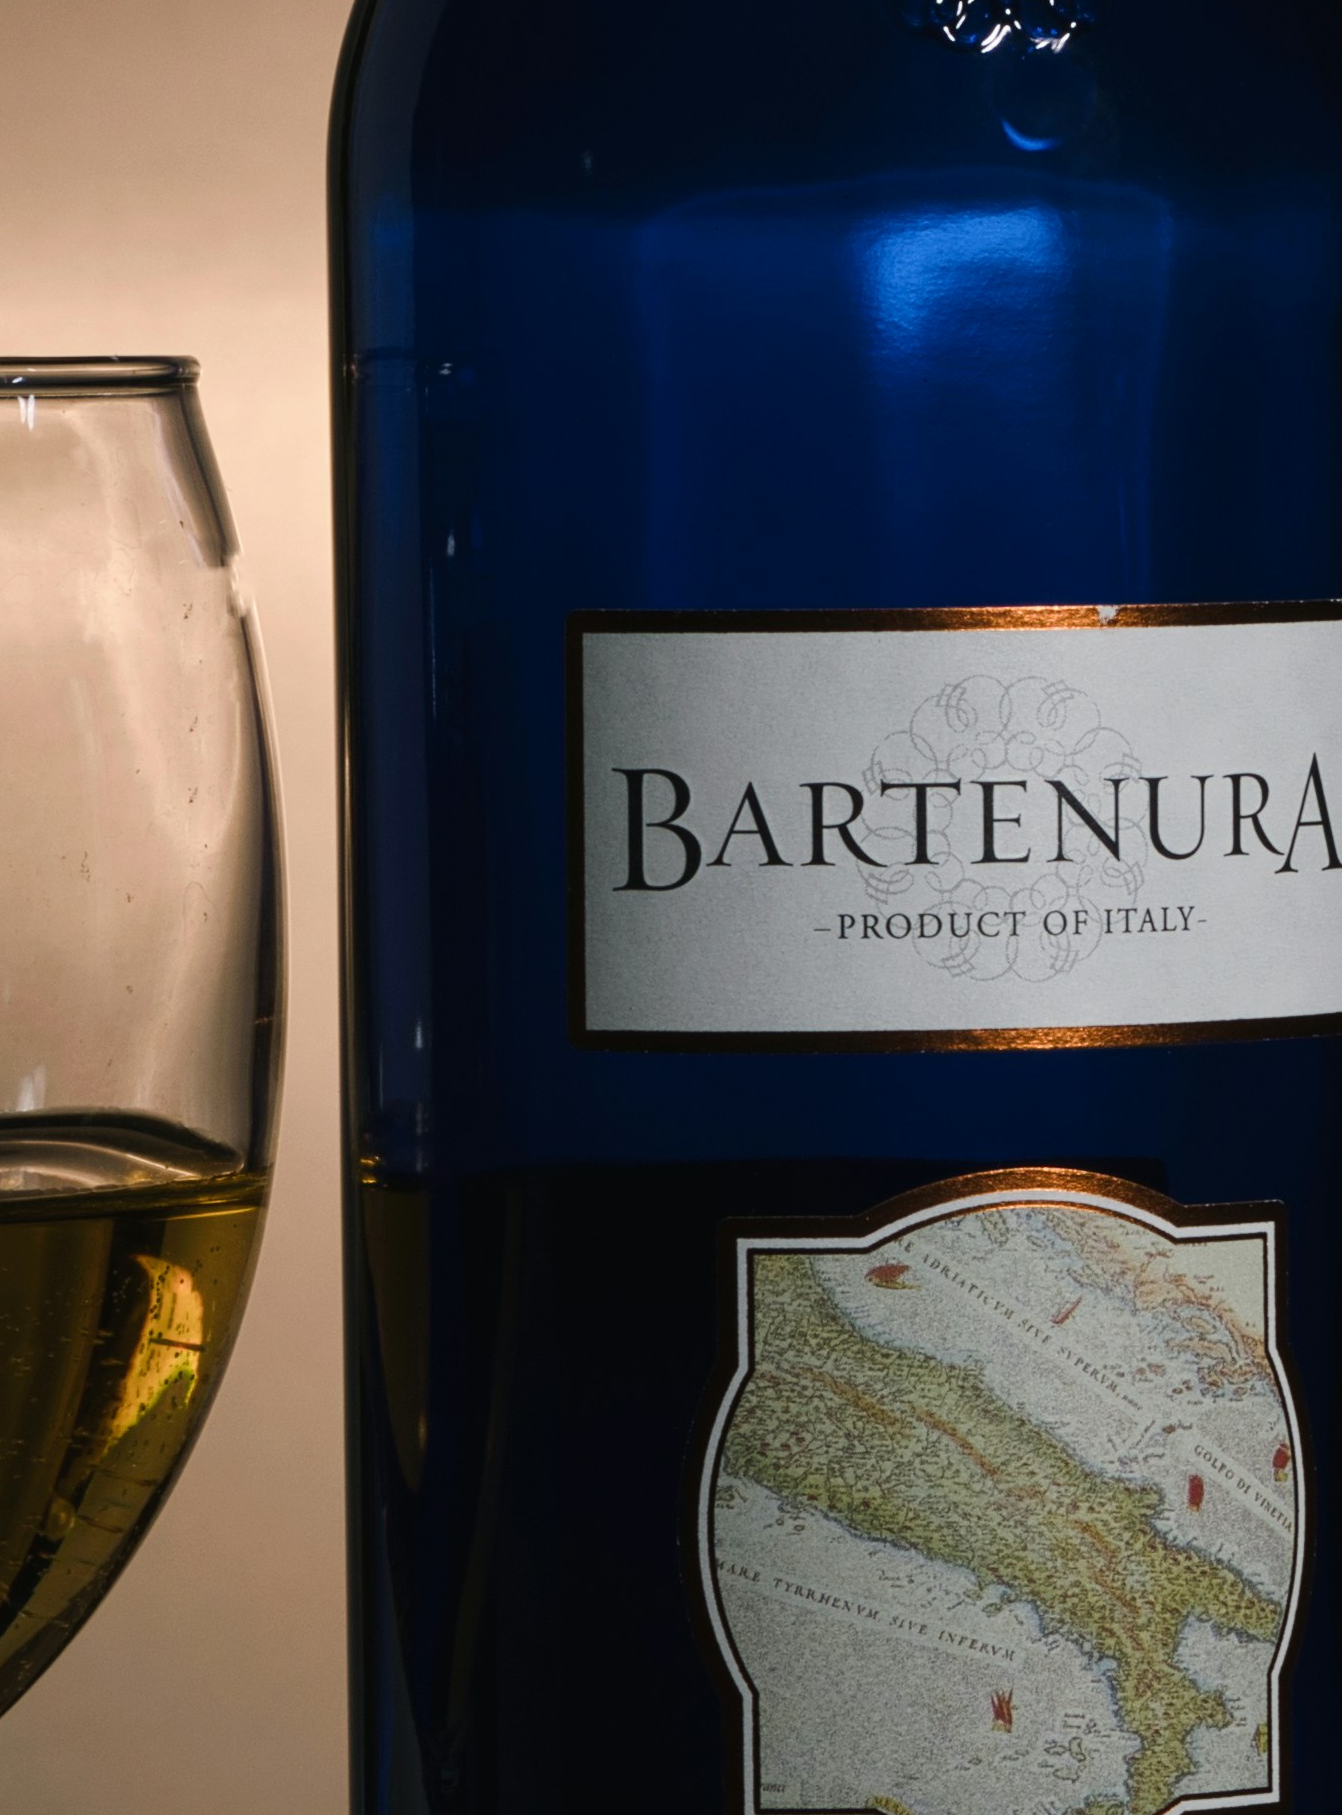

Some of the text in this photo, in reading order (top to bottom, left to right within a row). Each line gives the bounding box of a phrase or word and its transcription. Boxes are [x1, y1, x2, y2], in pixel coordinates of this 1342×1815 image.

[1042, 908, 1091, 937] OF
[1194, 1445, 1235, 1480] GOLFO
[888, 1615, 928, 1636] SIVE
[938, 1630, 1016, 1662] INFERVM
